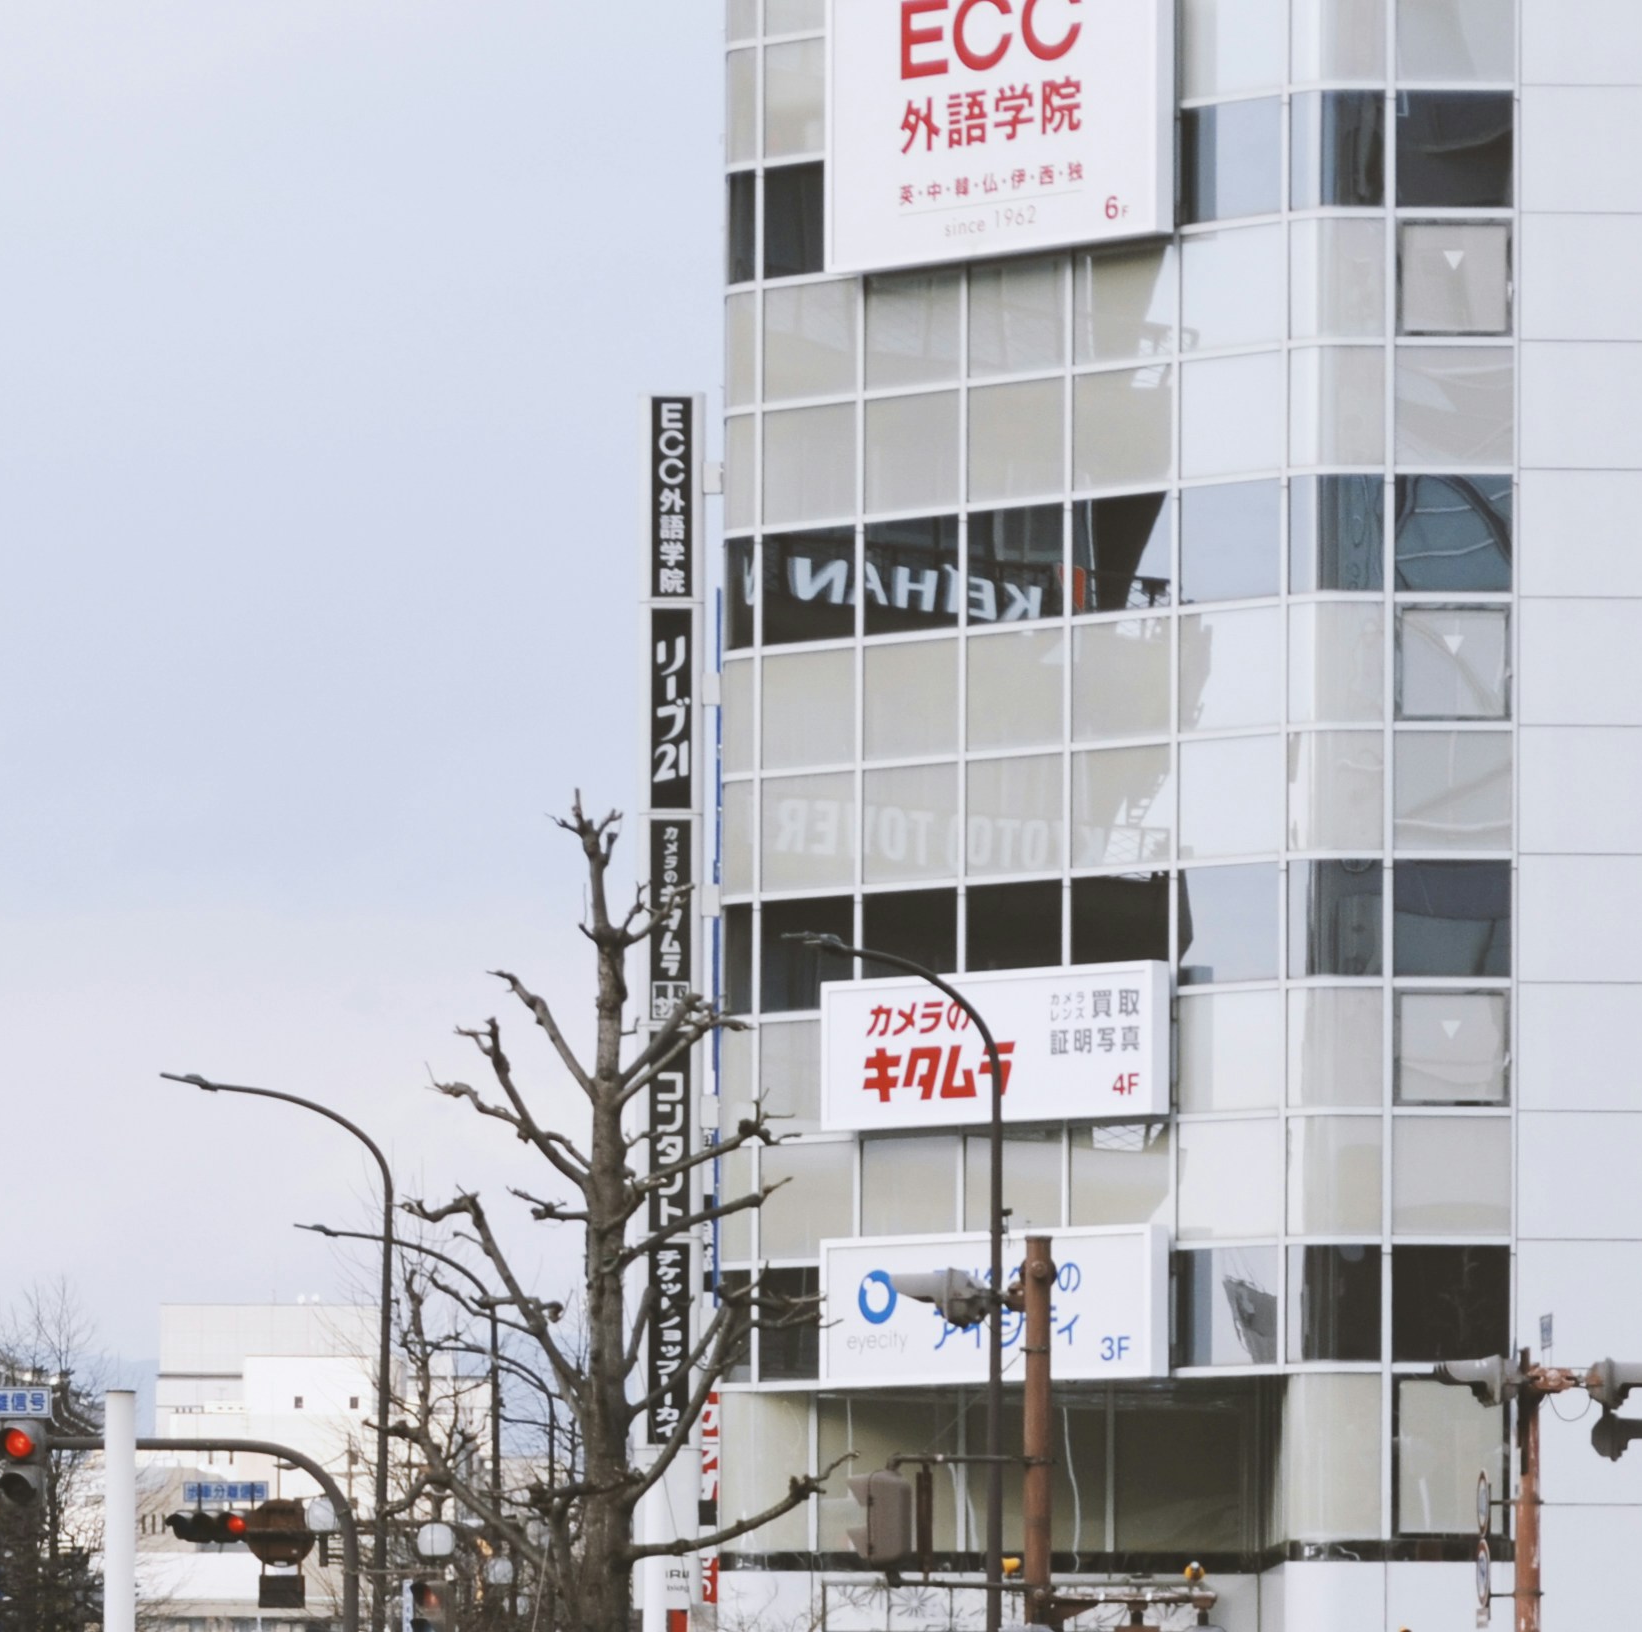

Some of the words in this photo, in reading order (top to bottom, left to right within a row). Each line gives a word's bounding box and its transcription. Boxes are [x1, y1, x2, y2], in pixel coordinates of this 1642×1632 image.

[900, 0, 1083, 79] ECC
[900, 76, 1082, 154] 外語学院
[944, 217, 987, 237] since
[994, 205, 1038, 229] 1962
[1104, 195, 1129, 220] 6F
[659, 403, 685, 594] ECC外語学院
[653, 636, 691, 784] リーブ21
[1050, 990, 1085, 1006] カメラ
[1091, 989, 1140, 1020] 買取
[867, 1000, 972, 1038] カメラの
[1050, 1007, 1085, 1023] レンズ
[1050, 1027, 1140, 1055] 証明写真
[863, 1041, 1016, 1103] キタムラ
[1112, 1074, 1140, 1095] 4F
[657, 1072, 684, 1227] コンタクト
[847, 1330, 908, 1356] eyecity
[1100, 1336, 1130, 1360] 3F
